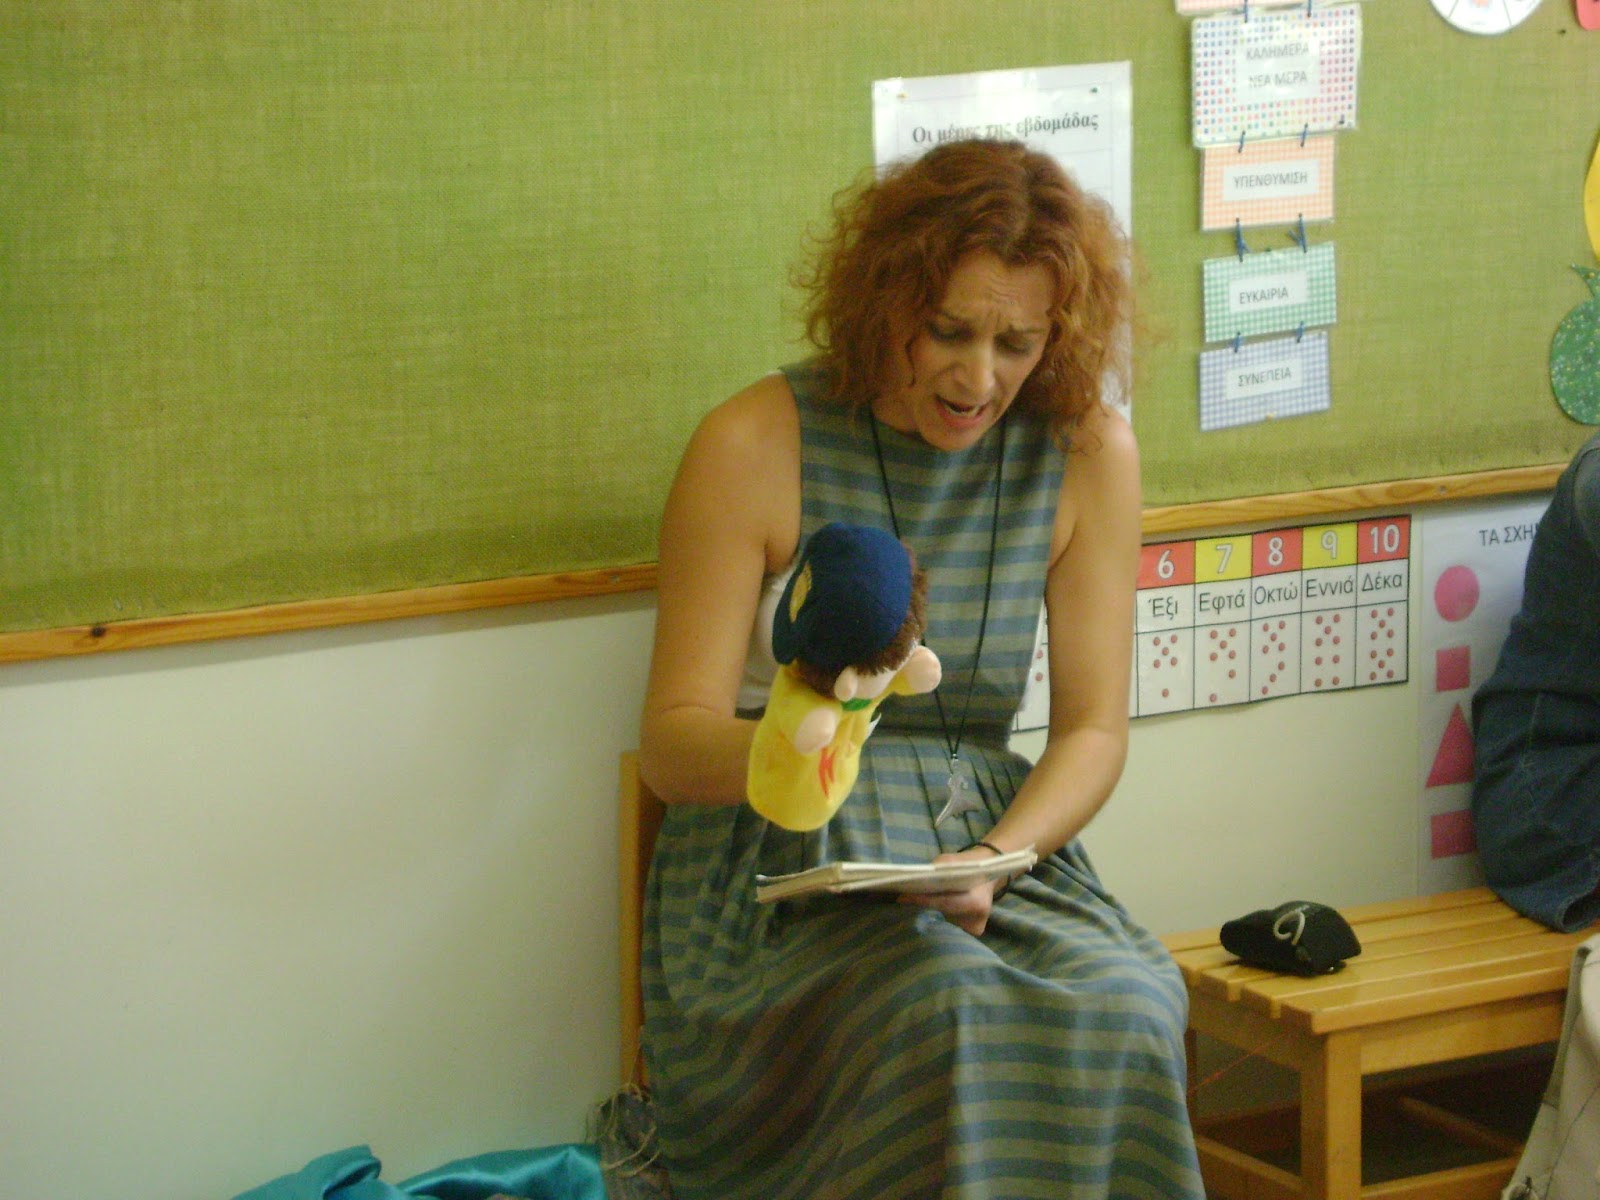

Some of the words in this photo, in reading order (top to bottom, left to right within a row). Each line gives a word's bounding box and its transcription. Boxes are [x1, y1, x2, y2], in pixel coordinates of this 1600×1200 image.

[1246, 42, 1309, 60] ΚΑΛΗΜΕΡΑ
[1274, 71, 1308, 86] ΜΕΡΑ
[912, 126, 932, 144] Οι
[1016, 112, 1099, 138] εβδομάδας
[1233, 171, 1308, 189] ΥΠΕΝΘΥΜΙΣΗ
[1239, 286, 1289, 305] ΕΥΚΑΙΡΙΑ
[1238, 367, 1292, 387] ΣΥΝΕΠΕΙΑ
[1479, 528, 1500, 547] ΤΑ
[1504, 523, 1539, 544] ΣΧΗ
[1157, 549, 1175, 579] 6
[1215, 543, 1233, 573] 7
[1267, 536, 1283, 566] 8
[1321, 530, 1337, 559] 9
[1370, 524, 1400, 554] 10
[1148, 596, 1178, 620] Έξι
[1199, 588, 1245, 613] Εφτά
[1253, 581, 1299, 605] Οκτώ
[1305, 574, 1355, 599] Εννιά
[1361, 570, 1403, 592] Δέκα
